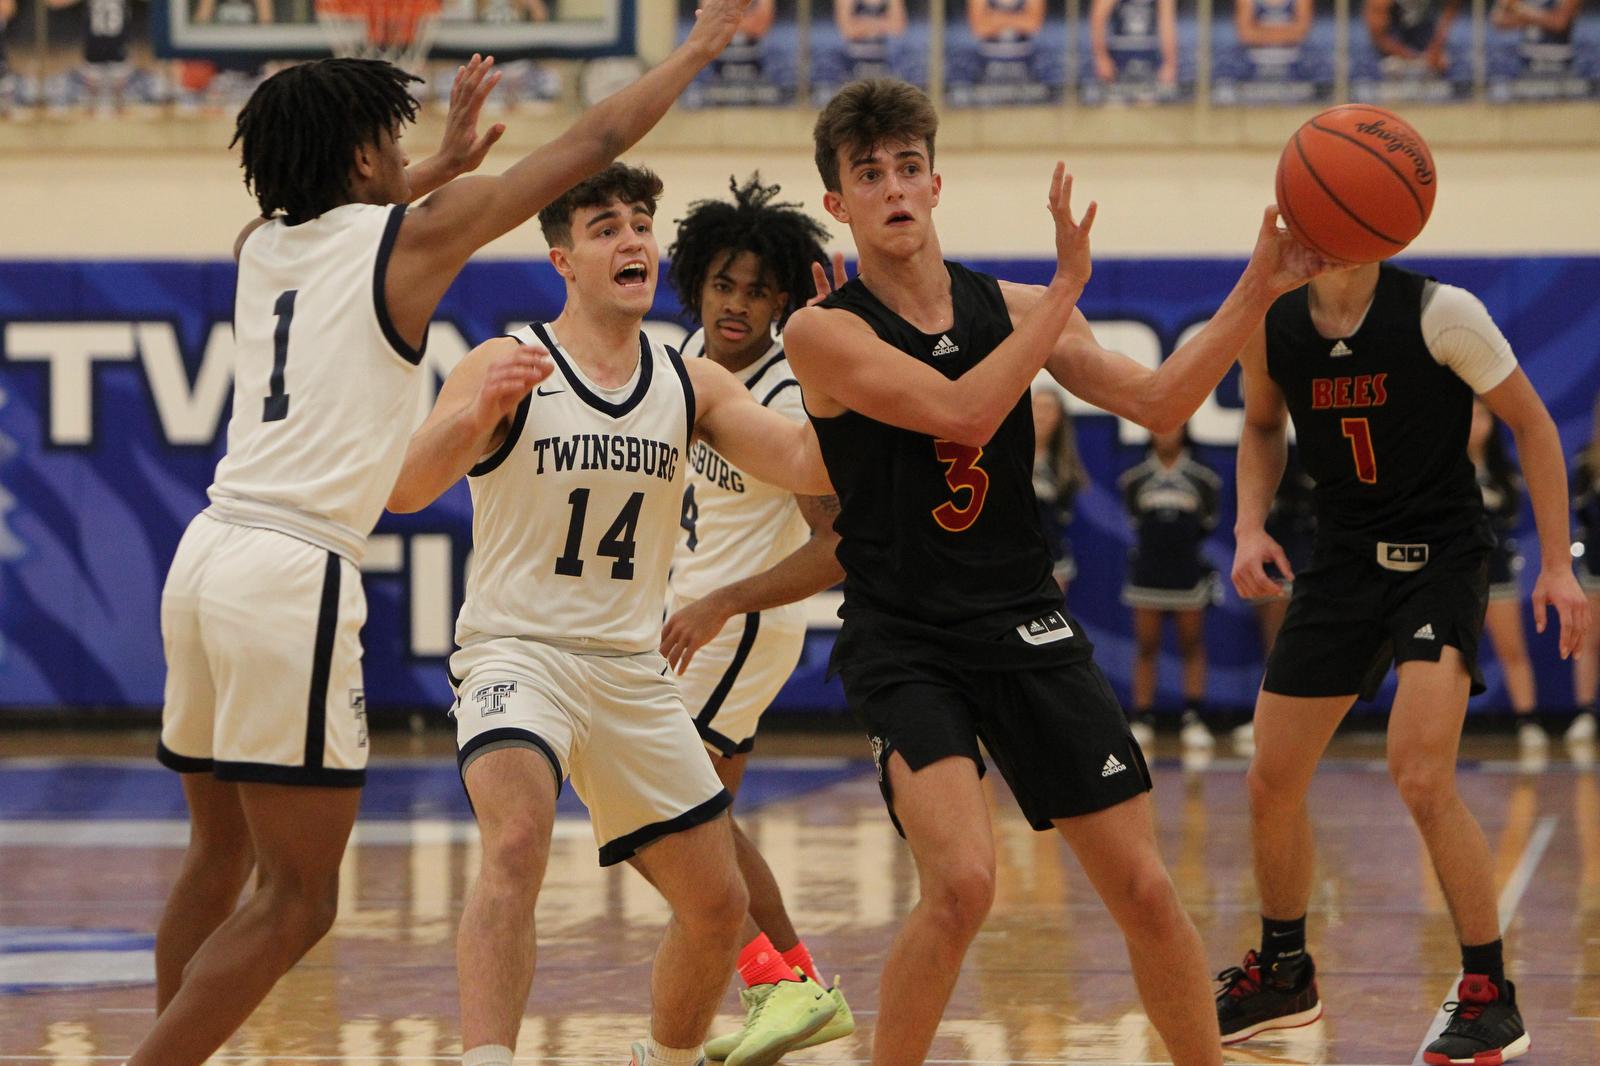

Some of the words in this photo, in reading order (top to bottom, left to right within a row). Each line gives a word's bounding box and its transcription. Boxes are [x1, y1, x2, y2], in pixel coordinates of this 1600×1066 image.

[262, 289, 299, 422] 1
[931, 345, 960, 357] adidas
[1312, 373, 1388, 409] BEES
[533, 434, 679, 483] TWINSBURG
[1341, 417, 1377, 484] 1
[931, 438, 989, 532] 3
[554, 487, 645, 580] 14
[1101, 763, 1127, 777] adidas
